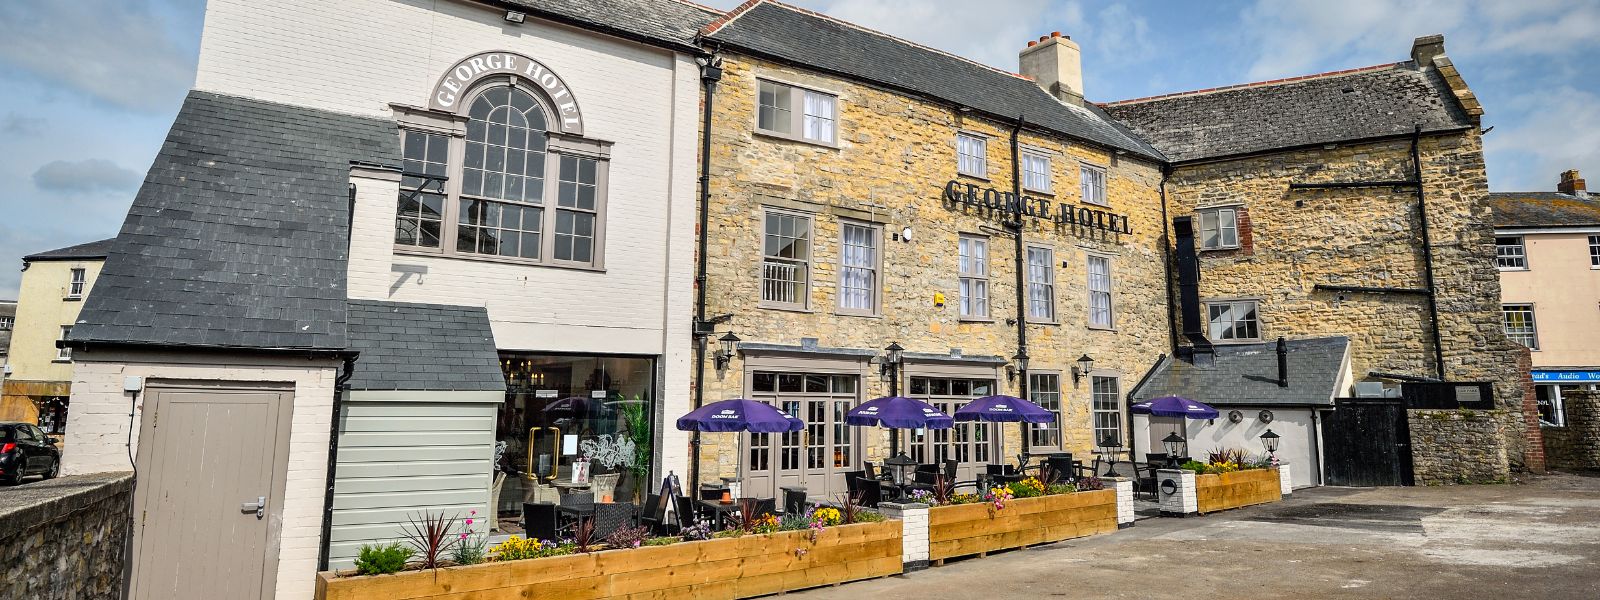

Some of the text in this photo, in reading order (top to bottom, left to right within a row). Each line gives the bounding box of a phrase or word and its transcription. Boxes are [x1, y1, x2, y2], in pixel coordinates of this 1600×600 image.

[437, 54, 579, 129] GEORGE HOTEL
[945, 179, 1133, 236] GEORGE HOTEL
[1557, 372, 1580, 380] Audio
